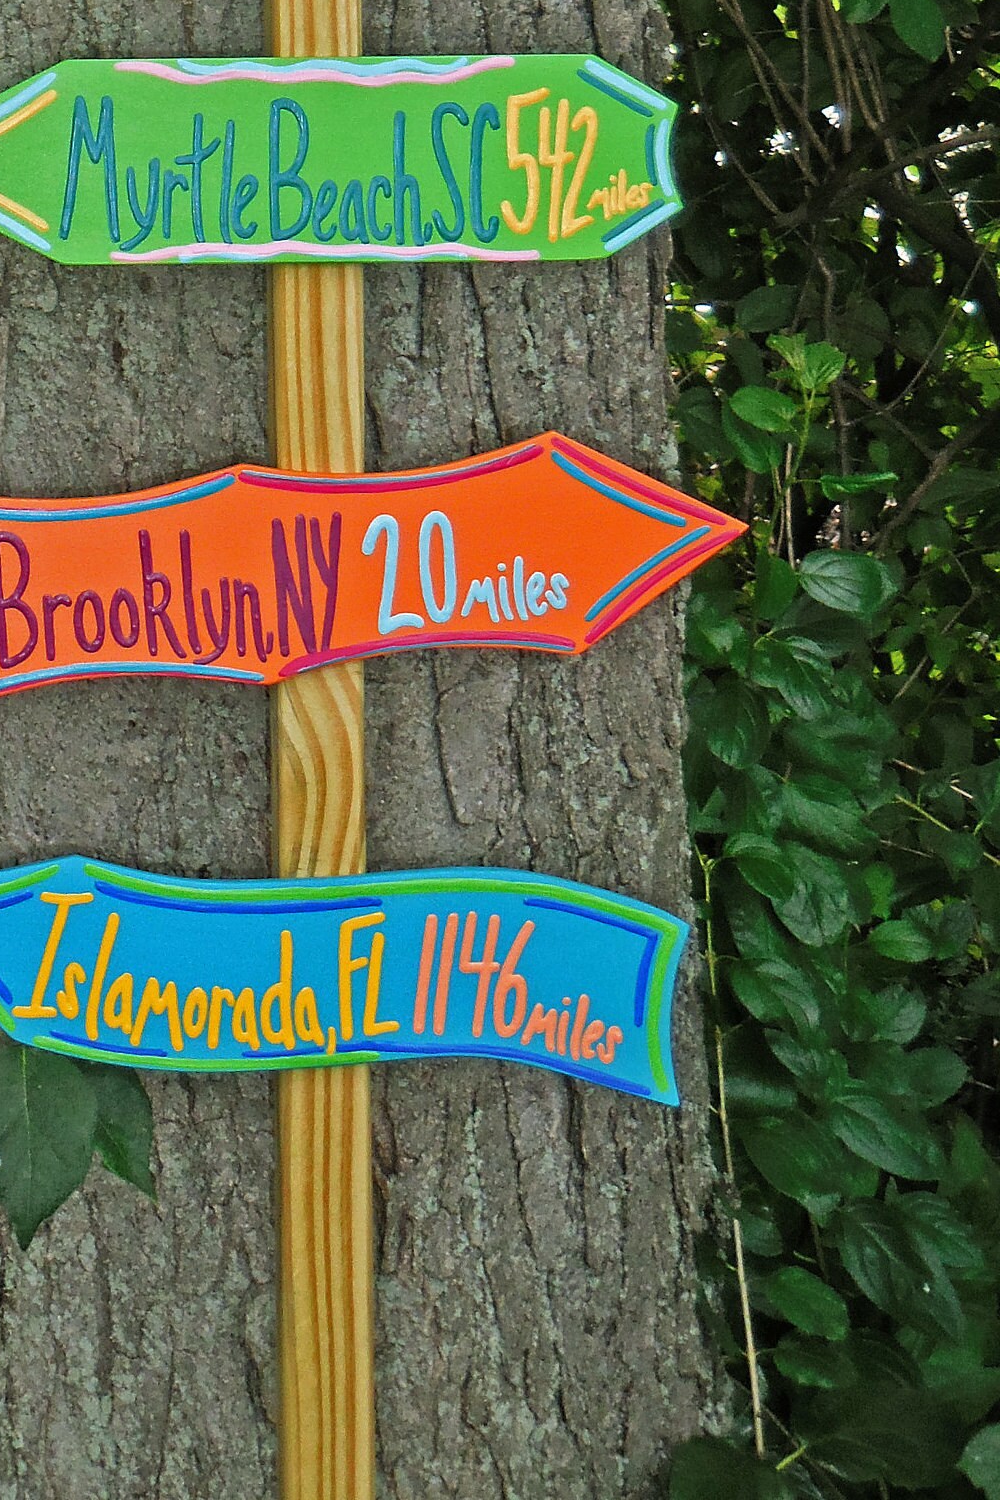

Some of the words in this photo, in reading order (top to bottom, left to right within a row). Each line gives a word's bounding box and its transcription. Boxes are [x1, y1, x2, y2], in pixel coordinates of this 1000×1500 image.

[59, 94, 259, 251] Myrtle
[430, 101, 502, 244] SC
[500, 87, 600, 242] 542
[585, 169, 654, 222] miles
[270, 510, 342, 656] NY
[360, 509, 460, 636] 20
[459, 555, 571, 624] miles
[336, 911, 400, 1041] FL
[412, 910, 536, 1038] 1146
[526, 992, 623, 1065] miles
